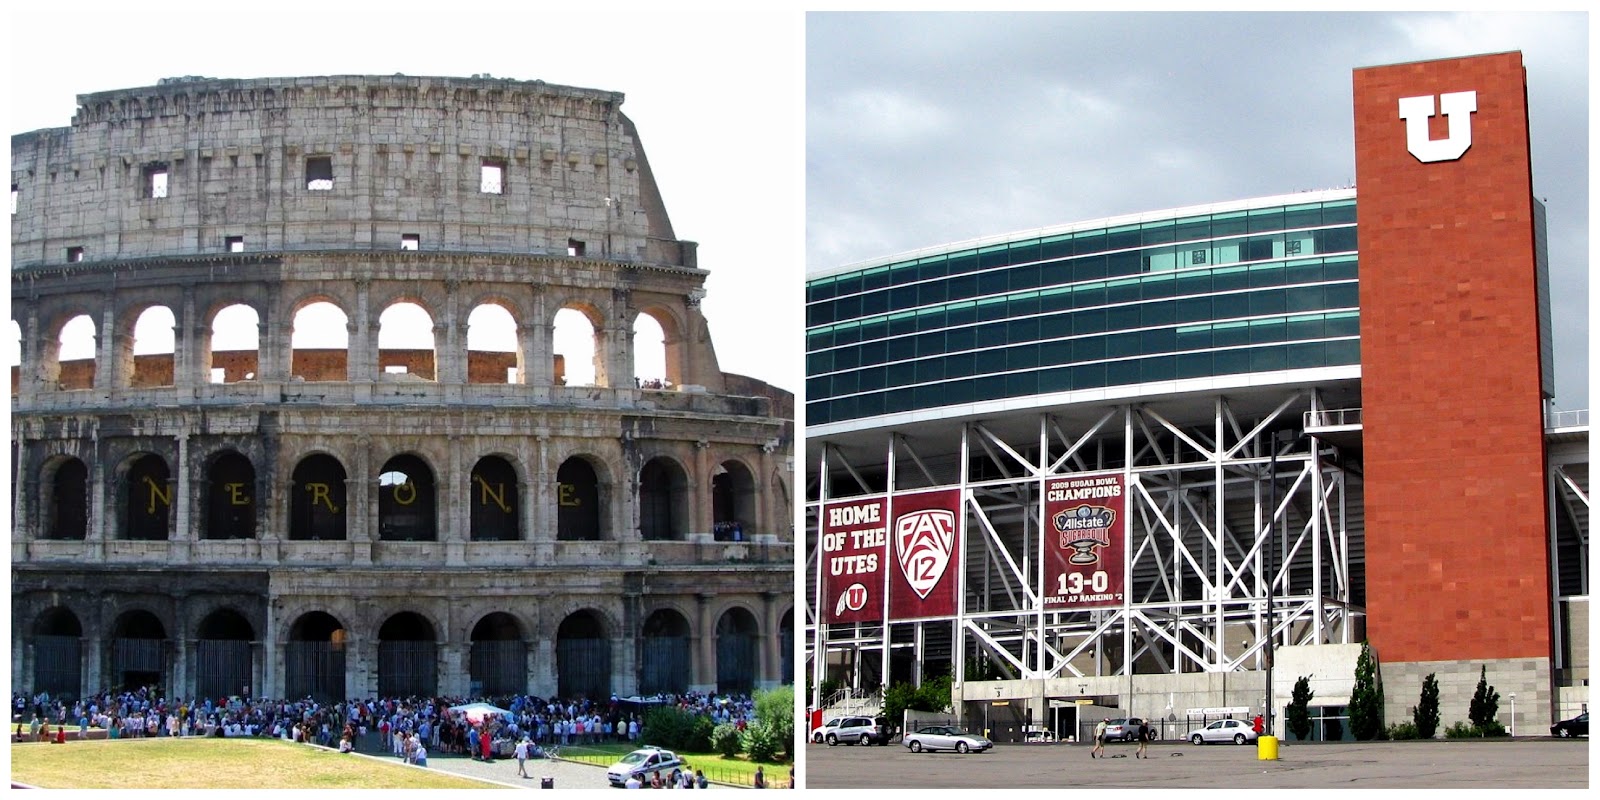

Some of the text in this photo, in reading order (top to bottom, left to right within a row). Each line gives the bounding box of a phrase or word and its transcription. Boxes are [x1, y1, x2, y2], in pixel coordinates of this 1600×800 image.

[1398, 90, 1477, 163] U
[1047, 485, 1122, 502] CHAMPIONS
[1051, 477, 1118, 490] 2009 SUGAR BOWL
[829, 503, 880, 527] HOME
[1062, 517, 1104, 530] Allstate
[823, 527, 886, 552] OF THE
[899, 512, 953, 566] PAC
[831, 553, 878, 576] UTES
[913, 556, 937, 582] 12
[1057, 570, 1108, 595] 13-0
[848, 588, 865, 609] U
[1067, 595, 1078, 603] AP
[1080, 594, 1113, 602] RANKING
[996, 690, 1001, 698] 3
[1080, 687, 1085, 695] 4
